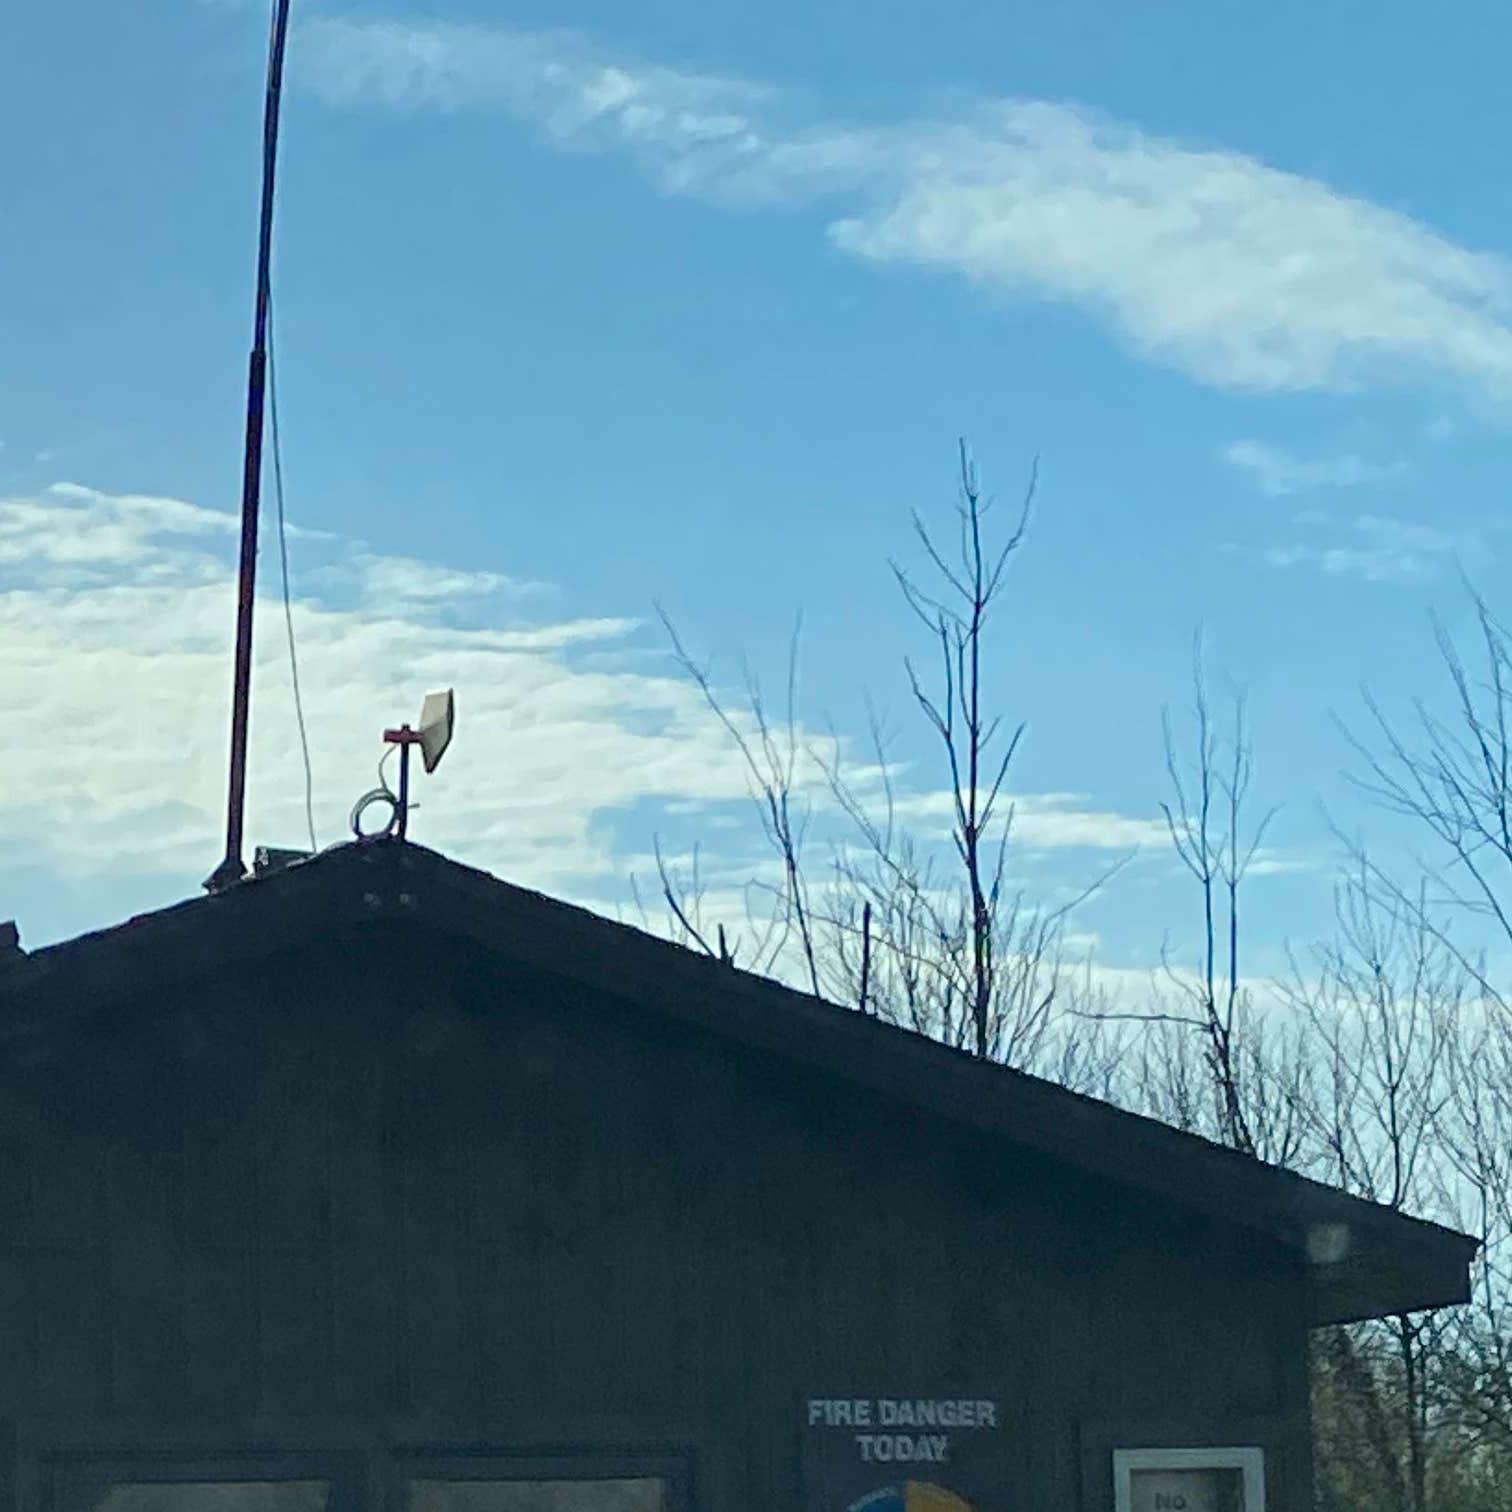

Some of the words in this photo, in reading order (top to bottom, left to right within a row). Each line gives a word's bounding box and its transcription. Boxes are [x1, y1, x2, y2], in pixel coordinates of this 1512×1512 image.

[808, 1400, 872, 1426] FIRE
[879, 1400, 997, 1427] DANGER
[855, 1435, 949, 1461] TODAY
[1154, 1492, 1187, 1511] No
